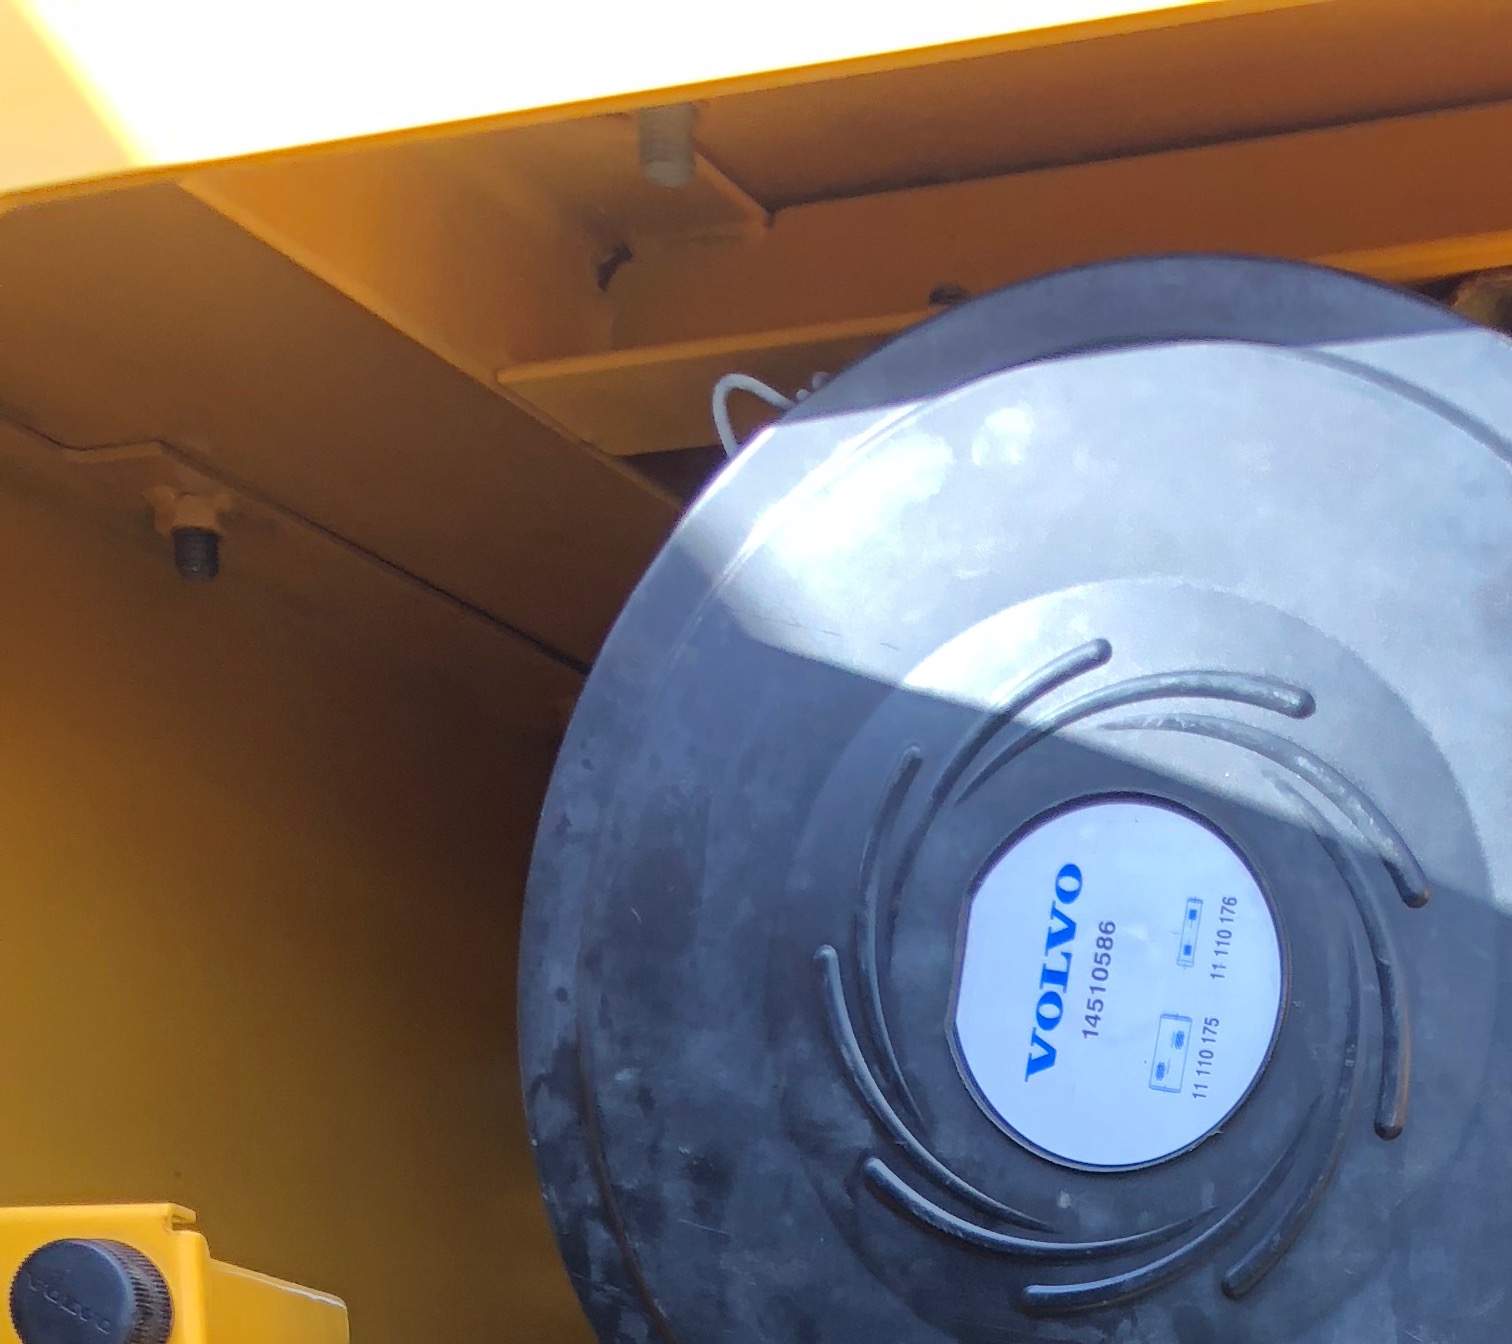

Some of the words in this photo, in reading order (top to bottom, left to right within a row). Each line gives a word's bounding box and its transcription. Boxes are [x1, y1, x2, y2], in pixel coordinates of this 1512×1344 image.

[1219, 896, 1239, 925] 176
[1214, 928, 1231, 957] 110
[1025, 863, 1083, 1082] VOLVO
[1083, 920, 1116, 1039] 14510586
[1201, 1017, 1220, 1046] 175
[1196, 1049, 1213, 1079] 110
